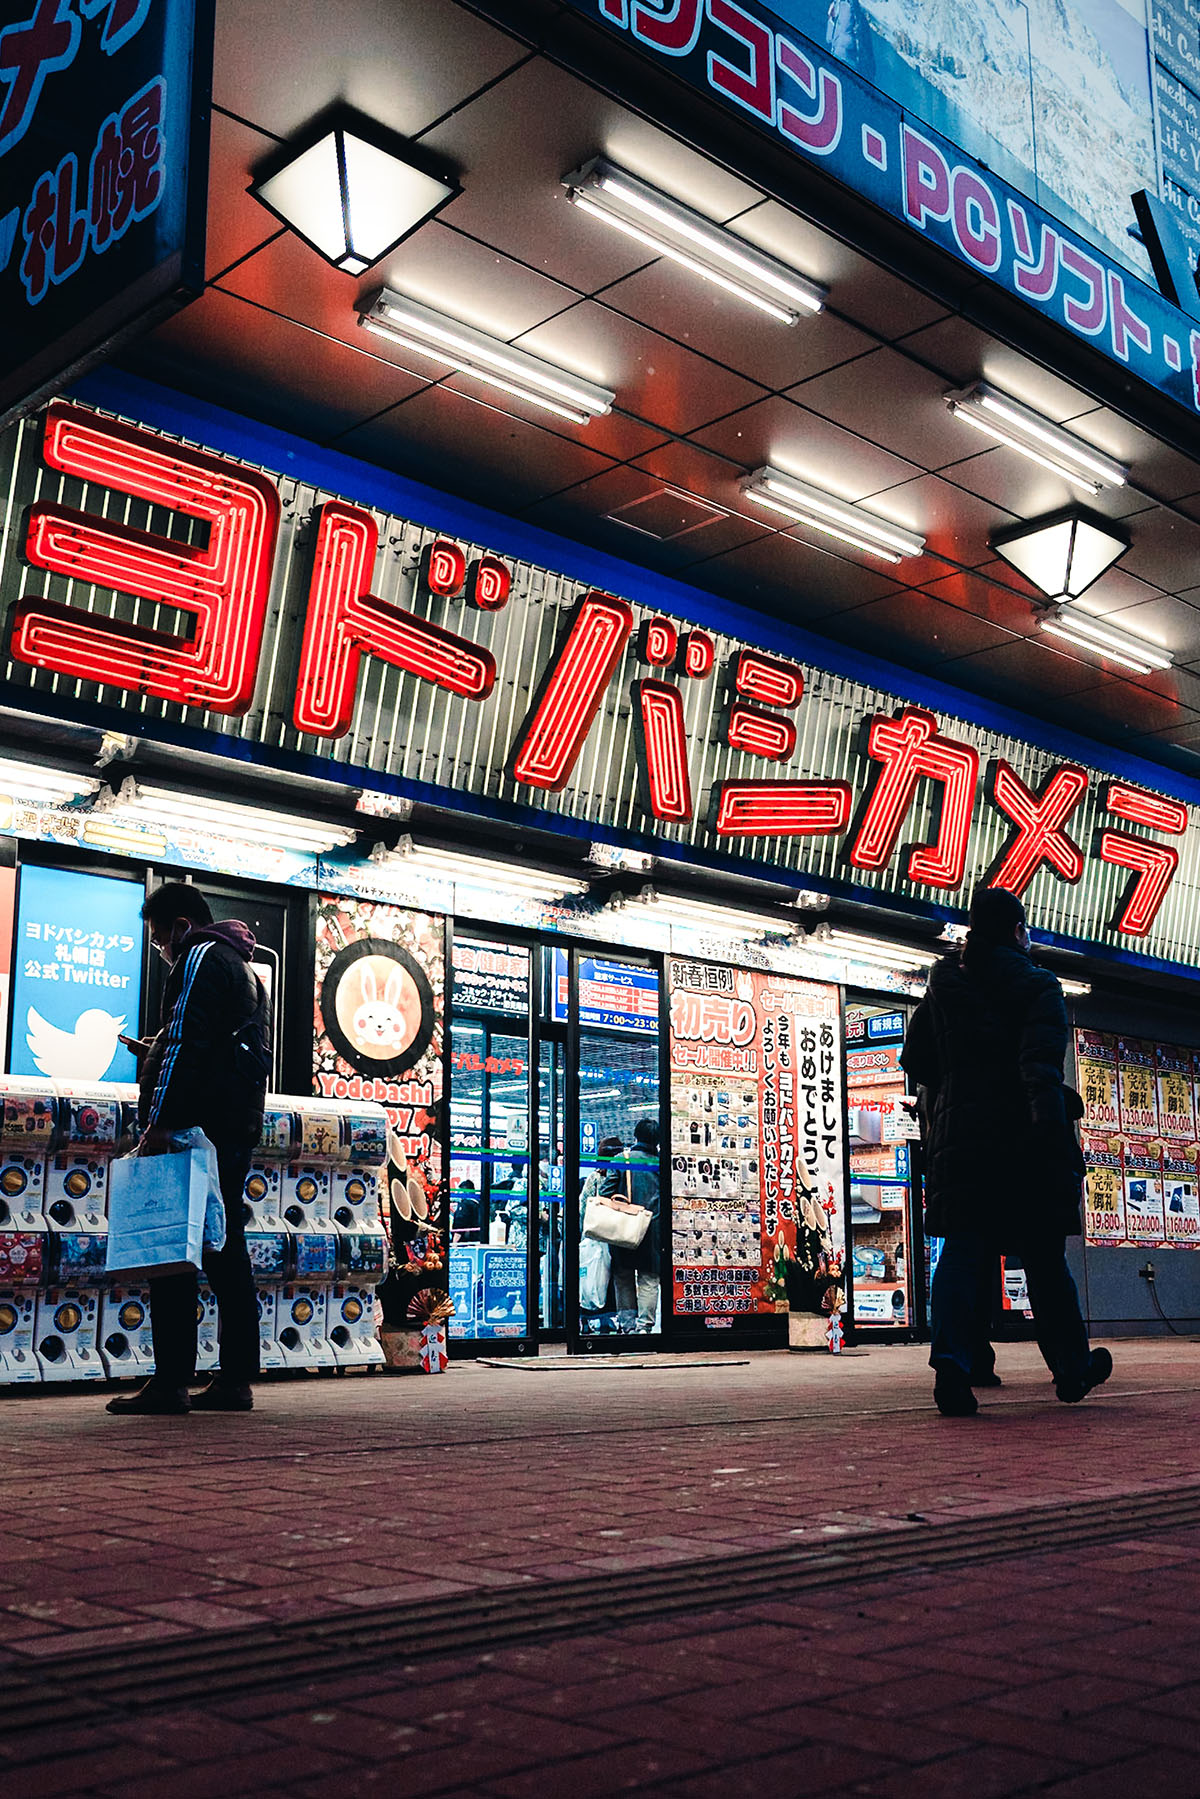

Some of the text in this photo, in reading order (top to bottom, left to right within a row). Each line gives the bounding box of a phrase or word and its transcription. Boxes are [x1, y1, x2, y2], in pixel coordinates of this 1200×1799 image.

[20, 74, 167, 306] 札幌
[4, 400, 1188, 938] ヨドバシカメラ
[26, 922, 135, 953] ヨドバシカメラ
[54, 943, 107, 967] 札幌店
[670, 990, 756, 1046] 初売り
[320, 1073, 433, 1106] Yodobashi
[819, 1022, 837, 1159] あけまして
[762, 1018, 779, 1237] よろしくお願いいたします
[684, 1284, 751, 1298] 多数各売り場にて
